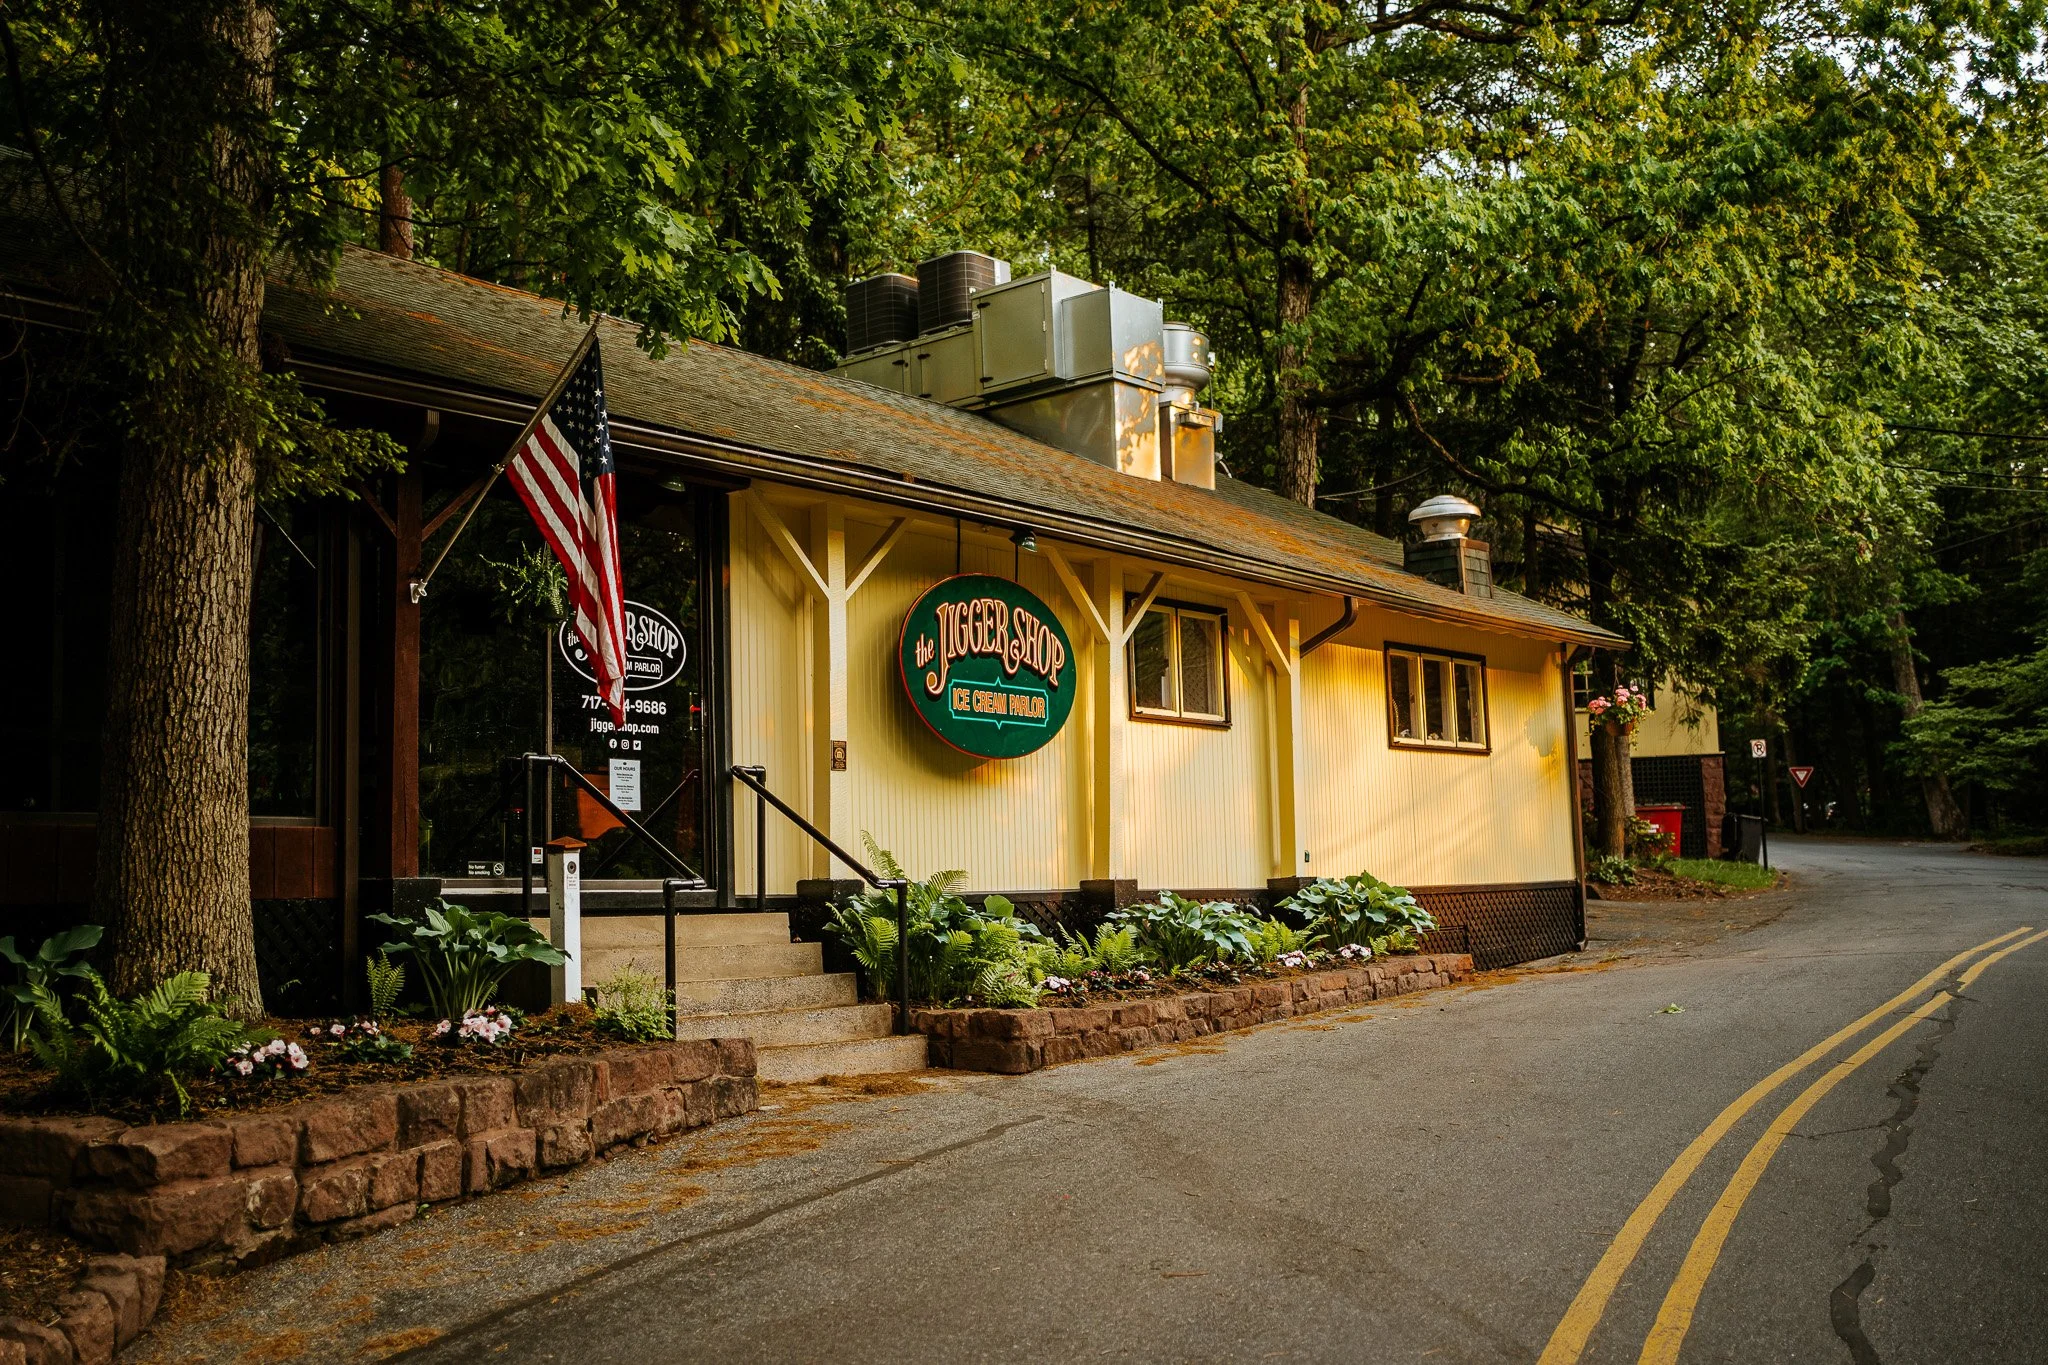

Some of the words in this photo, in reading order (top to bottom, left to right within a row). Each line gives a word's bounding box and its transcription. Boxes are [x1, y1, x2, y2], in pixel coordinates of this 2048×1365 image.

[637, 615, 679, 659] SHOP
[915, 633, 935, 669] the
[926, 598, 1012, 695] JIGGER
[1010, 607, 1065, 687] SHOP
[634, 661, 661, 674] PARLOR
[581, 694, 667, 715] 717-4-9686
[952, 687, 970, 711] ICE
[972, 690, 1007, 715] CREAM
[1009, 693, 1046, 719] PARLOR
[590, 717, 660, 735] jiggehop.com
